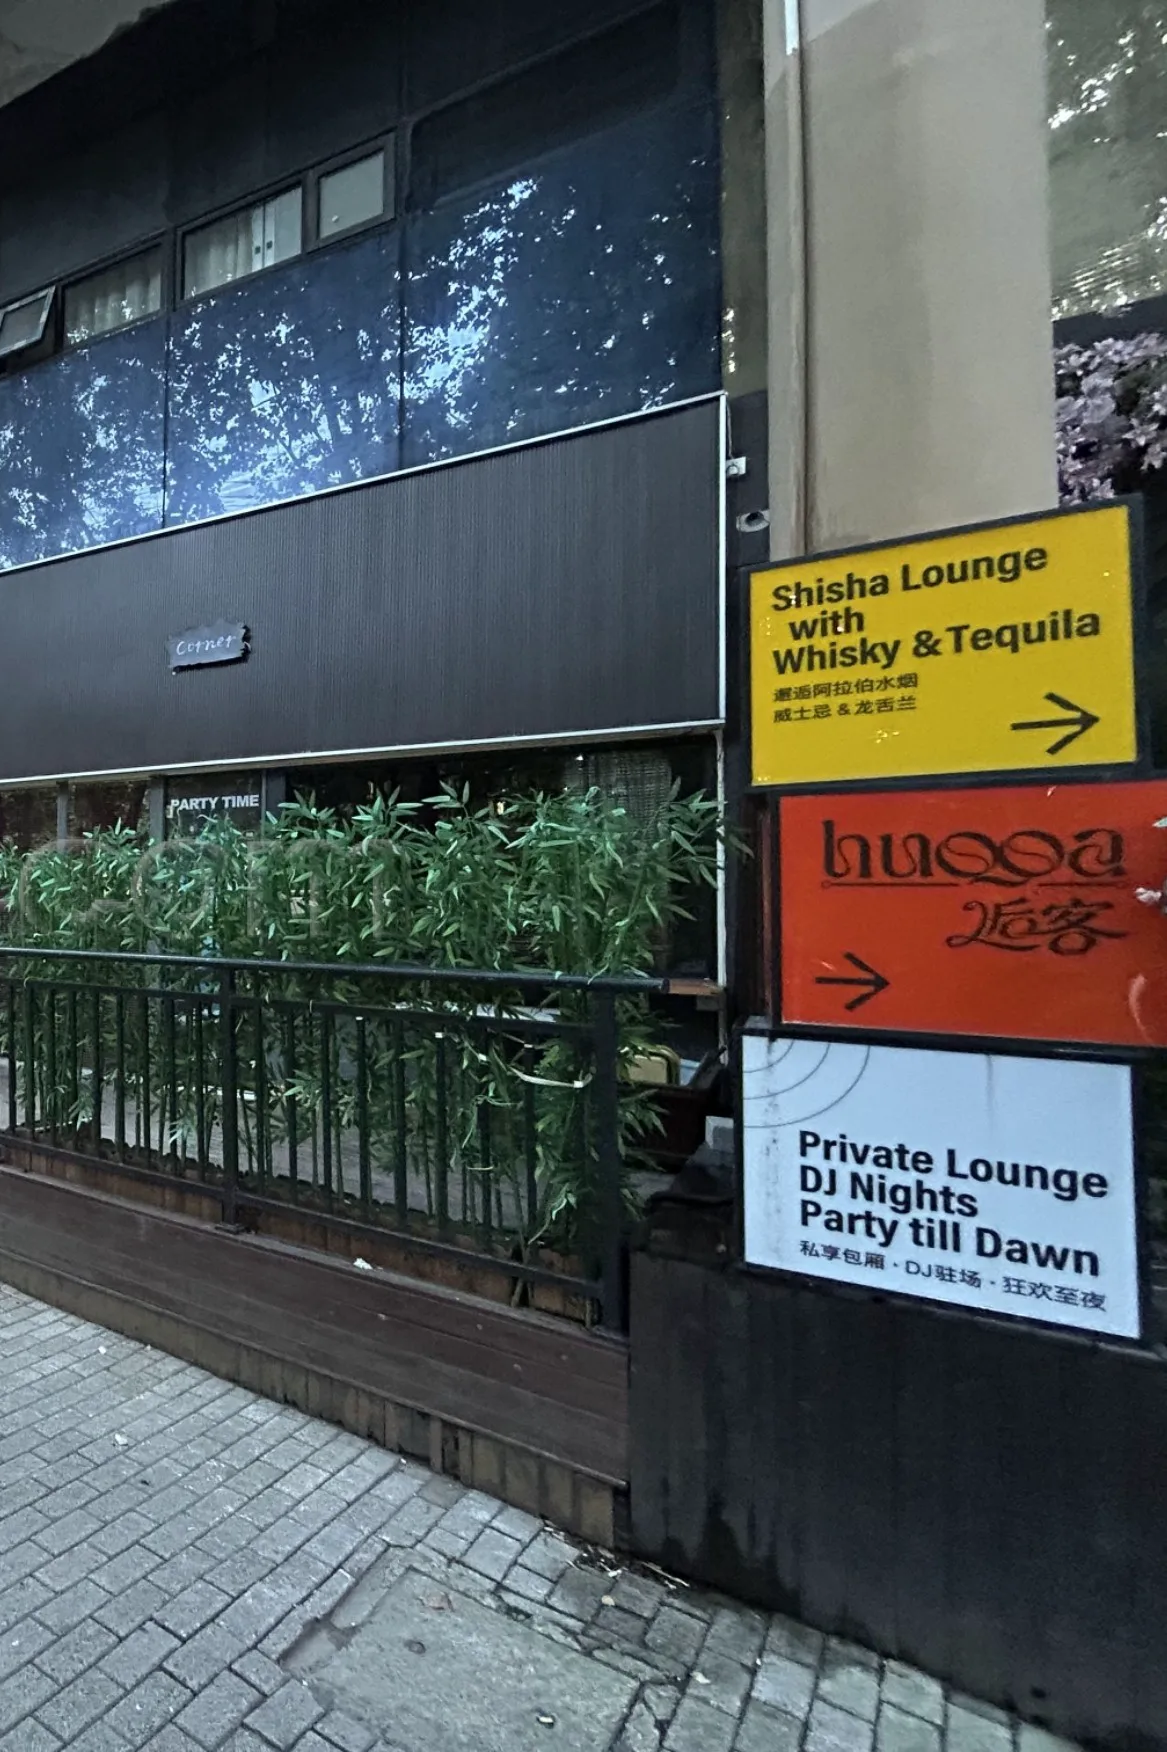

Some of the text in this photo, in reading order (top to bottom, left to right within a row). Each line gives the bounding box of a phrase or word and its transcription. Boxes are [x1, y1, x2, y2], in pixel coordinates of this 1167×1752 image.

[772, 547, 1048, 612] Shisha Lounge
[176, 634, 237, 656] Corner
[772, 637, 901, 675] Whisky
[946, 608, 1101, 654] Tequila
[789, 606, 865, 641] with
[773, 672, 919, 703] 邂逅阿拉伯水烟
[168, 794, 260, 812] PARTY TIME
[799, 1130, 1109, 1200] Private Lounge
[800, 1164, 979, 1218] DJ Nights
[800, 1199, 1100, 1277] Party till Dawn
